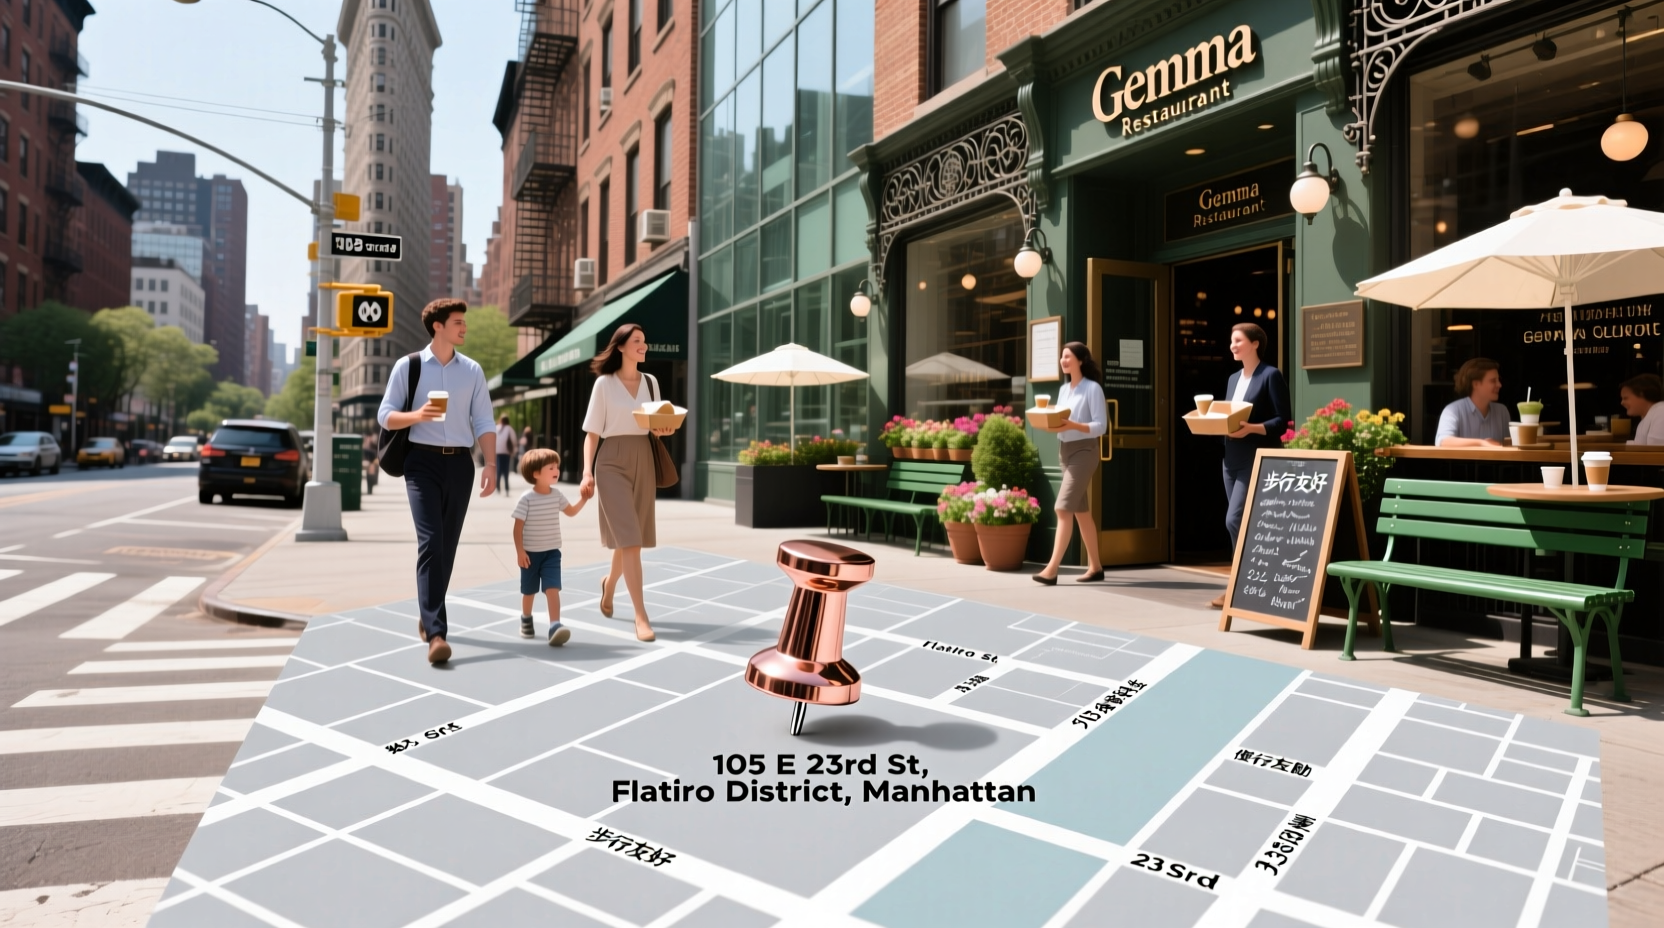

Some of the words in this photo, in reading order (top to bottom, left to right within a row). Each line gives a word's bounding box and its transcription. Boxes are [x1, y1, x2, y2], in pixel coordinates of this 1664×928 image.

[1092, 24, 1257, 123] Gemma
[1121, 79, 1231, 137] Restaurant
[1199, 182, 1260, 210] Gemma
[1261, 470, 1329, 494] 步行友好
[585, 827, 677, 867] 步行友好
